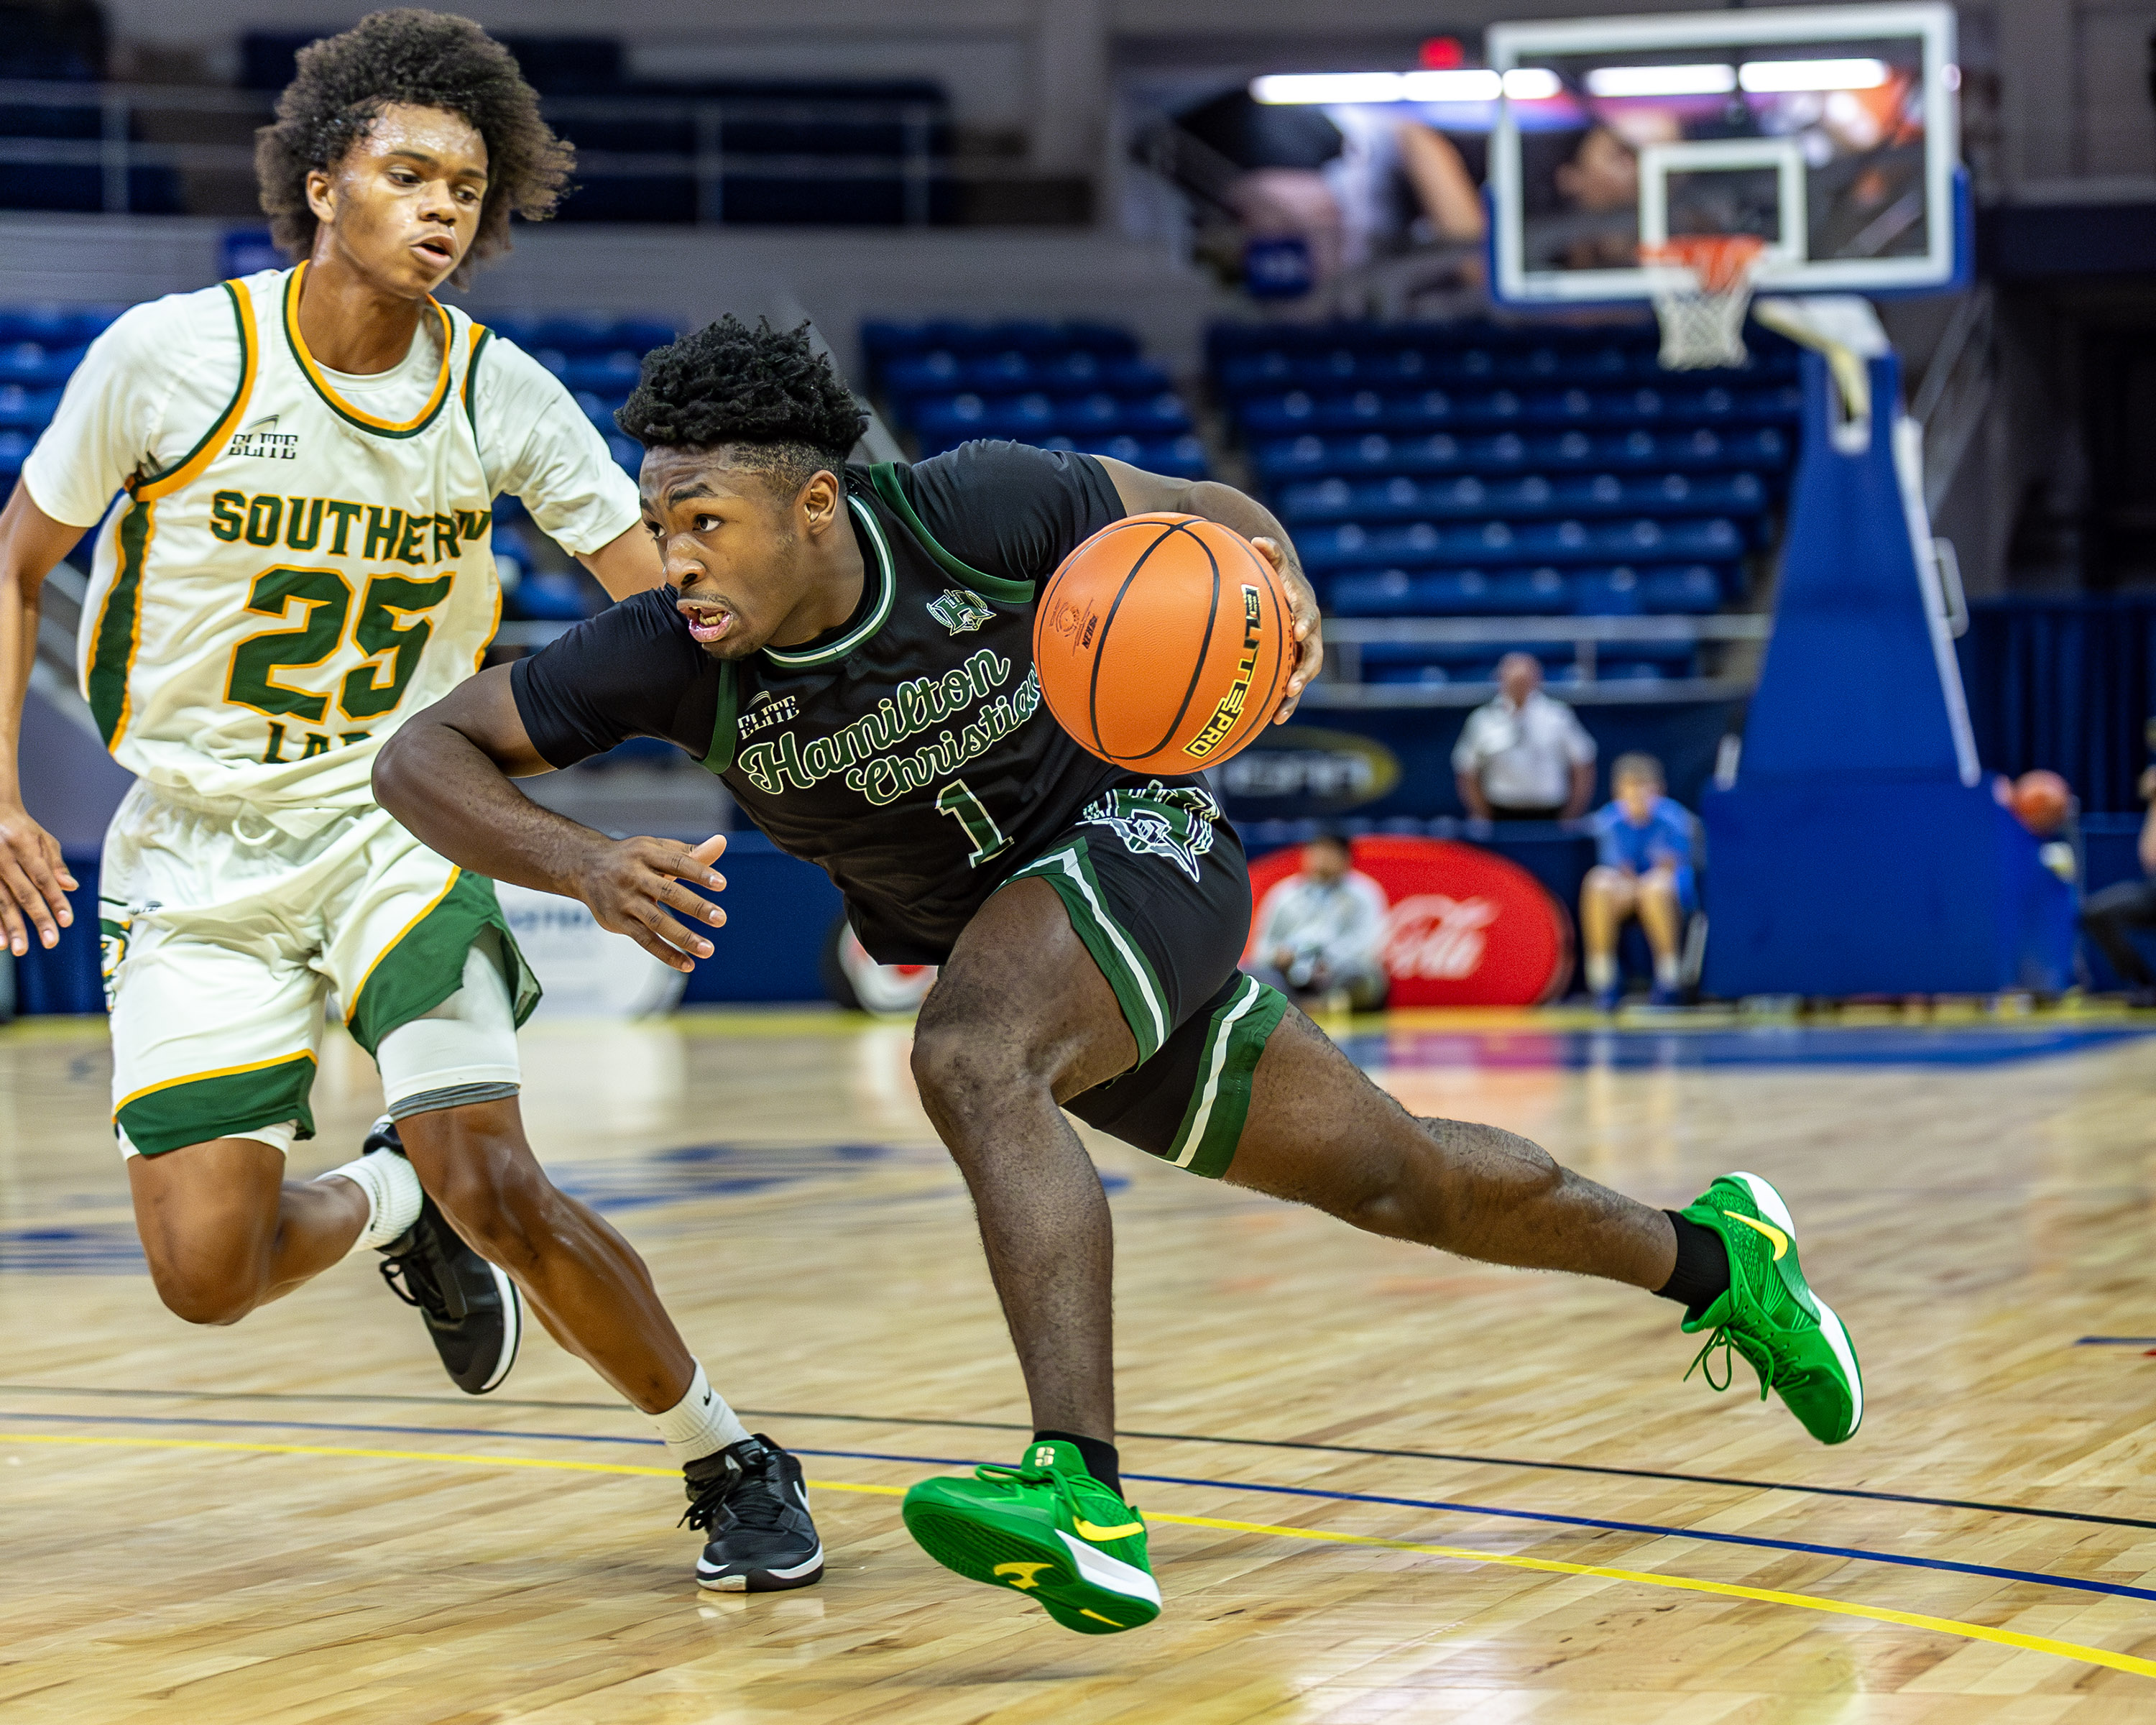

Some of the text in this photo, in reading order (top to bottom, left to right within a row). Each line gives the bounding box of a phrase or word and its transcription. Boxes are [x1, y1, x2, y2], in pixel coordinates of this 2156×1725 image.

[229, 433, 298, 460] ELITE
[209, 489, 492, 566] SOUTHERN
[223, 564, 457, 724] 25
[737, 696, 800, 740] ELITE
[738, 648, 1010, 794] Hamilton
[934, 778, 1015, 869] 1
